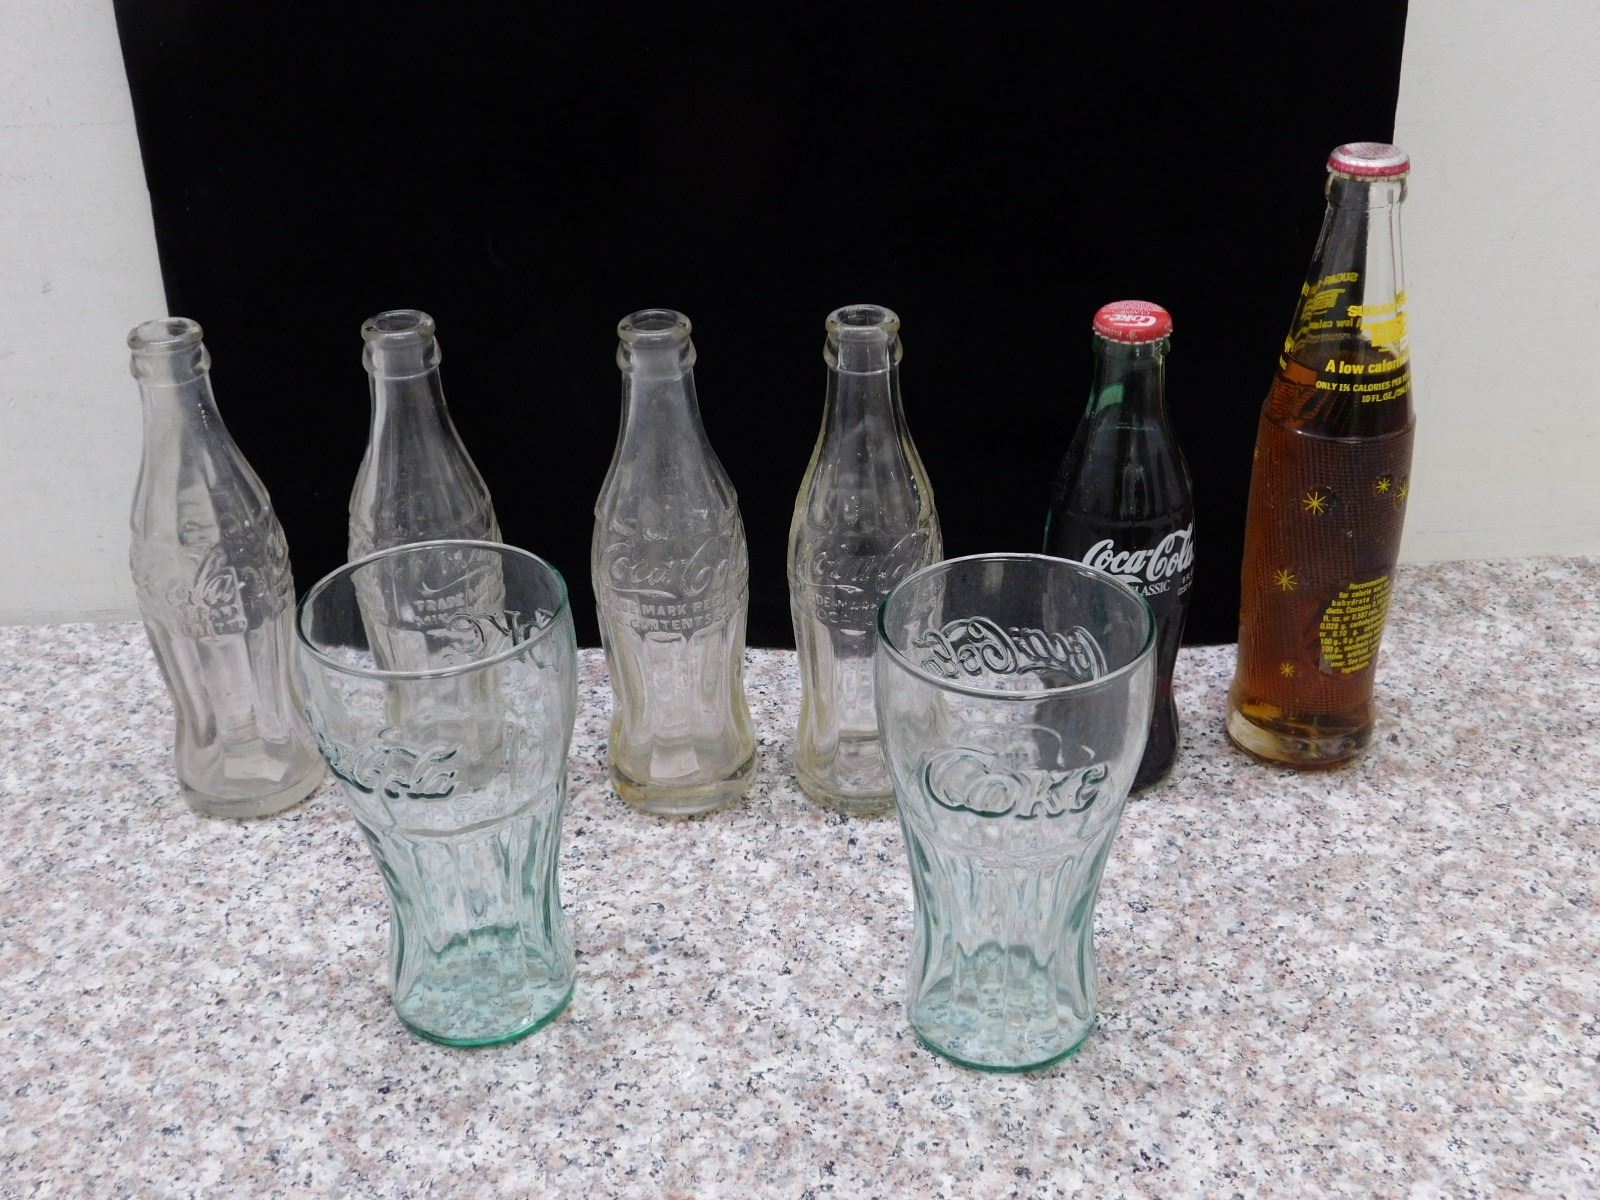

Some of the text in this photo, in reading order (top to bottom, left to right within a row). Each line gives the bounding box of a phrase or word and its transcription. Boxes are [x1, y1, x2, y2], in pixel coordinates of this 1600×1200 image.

[1325, 356, 1410, 375] A low calori
[1315, 381, 1338, 391] ONLY
[1352, 381, 1391, 392] CALORIES
[1081, 522, 1194, 583] Coca-Cola
[1131, 579, 1171, 596] LASSIC
[641, 604, 688, 617] MARK
[923, 750, 1109, 820] Coke
